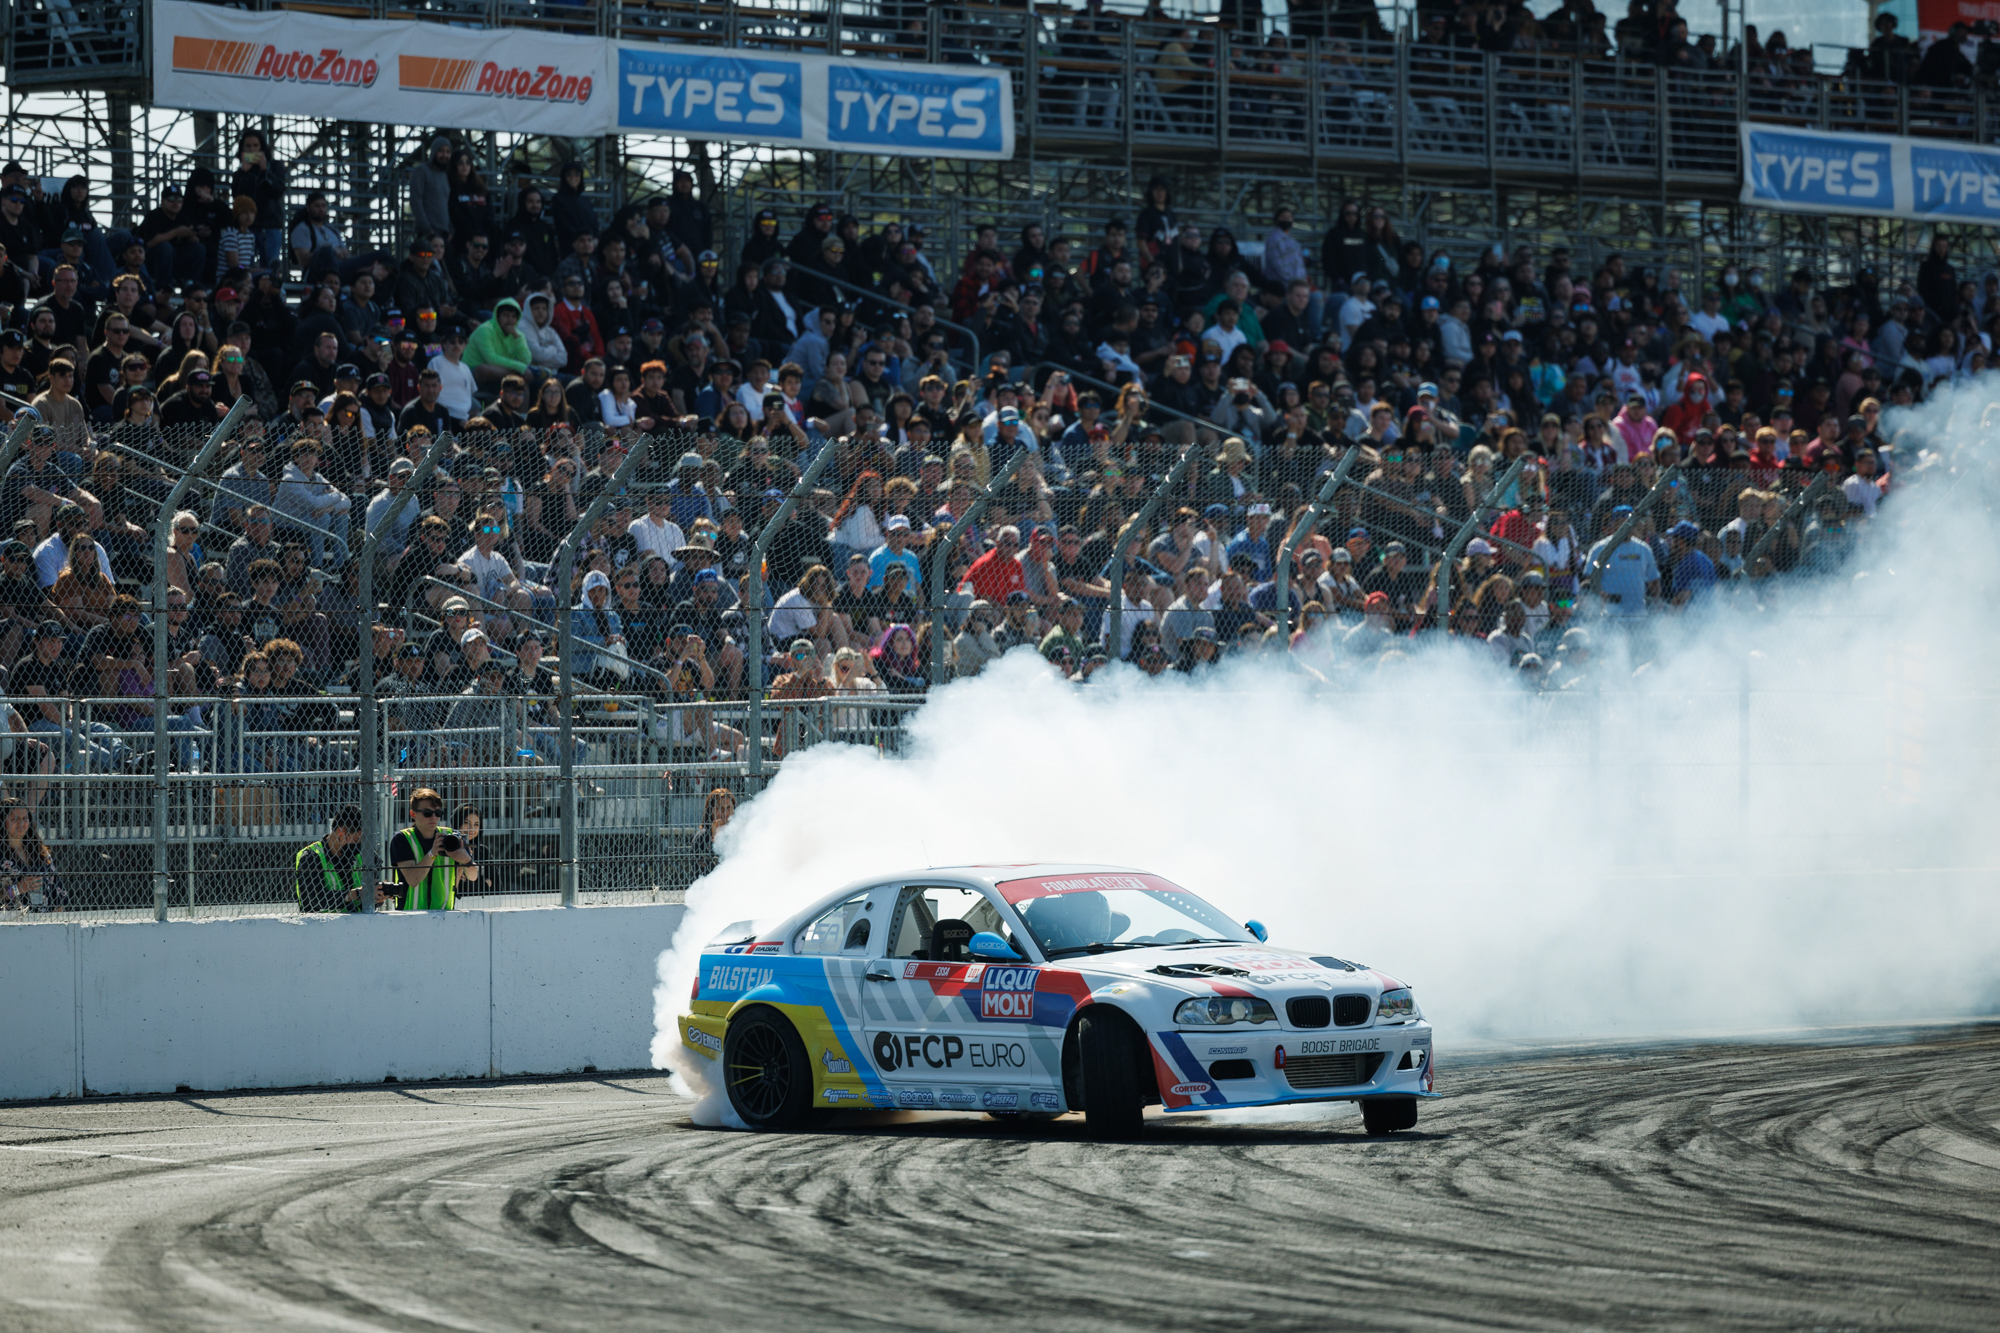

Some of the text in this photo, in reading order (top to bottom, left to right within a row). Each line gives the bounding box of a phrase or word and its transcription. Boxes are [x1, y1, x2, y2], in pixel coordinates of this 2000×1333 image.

[254, 44, 378, 87] AutoZone
[627, 60, 748, 81] TOURING ITEMS
[476, 61, 593, 103] AutoZone
[1041, 876, 1149, 893] FORMULA DRIFT
[976, 941, 1007, 949] sparco
[935, 967, 950, 976] ESSA
[967, 967, 980, 978] 101
[1246, 961, 1314, 970] MOLY
[708, 966, 774, 991] BILSTEIN
[985, 968, 1036, 992] LIQUI
[1275, 972, 1322, 982] FCP
[984, 993, 1033, 1016] MOLY
[702, 1032, 722, 1052] ENKEI
[1301, 1038, 1380, 1053] BOOST BRIGADE
[904, 1035, 1026, 1068] FCP EURO
[1208, 1047, 1248, 1055] ICONWRAP
[1174, 1084, 1208, 1094] CORTECO
[900, 1091, 933, 1103] sparco
[940, 1093, 976, 1103] ICONWRAP
